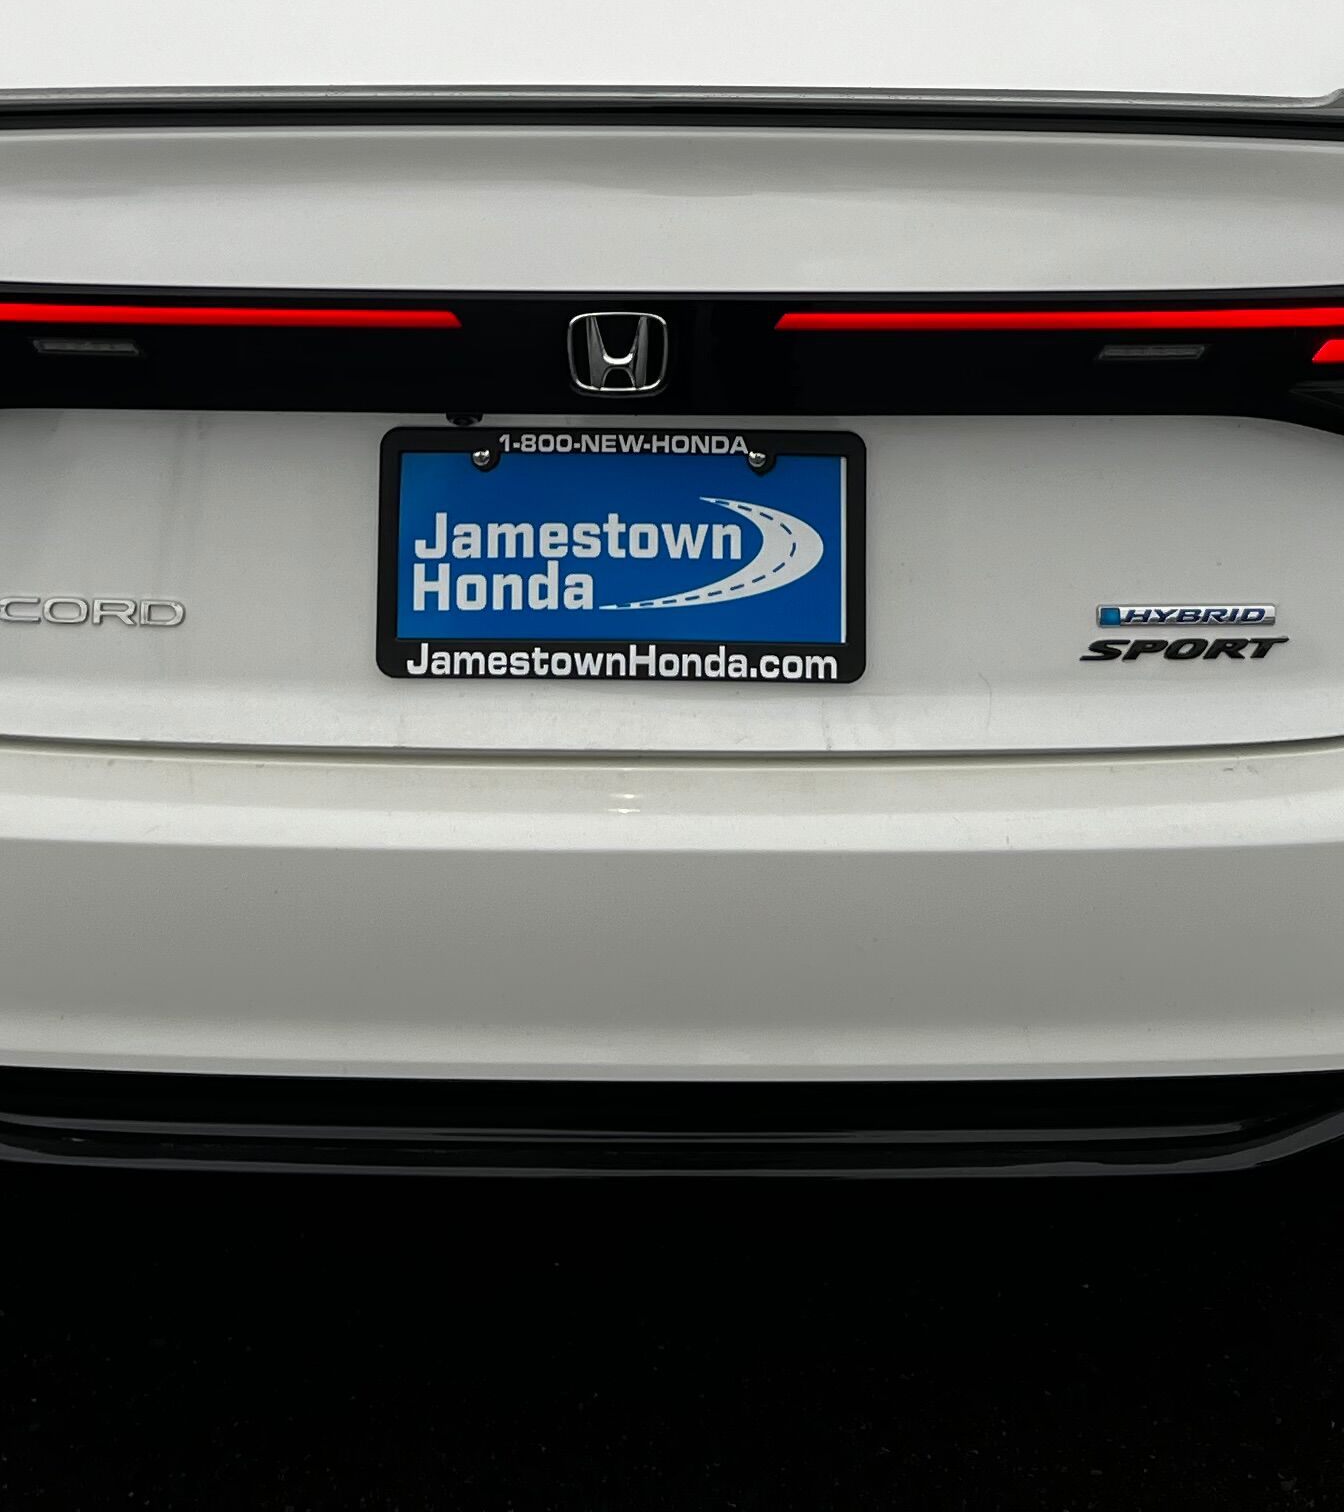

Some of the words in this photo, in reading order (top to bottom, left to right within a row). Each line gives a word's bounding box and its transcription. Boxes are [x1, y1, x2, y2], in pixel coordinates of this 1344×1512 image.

[499, 434, 749, 455] 1-800-NEW-HONDA
[414, 512, 743, 560] Jamestown
[413, 561, 594, 611] Honda
[1124, 608, 1266, 624] HYBRID
[406, 642, 838, 680] JamestownHonda.com
[1079, 635, 1290, 661] SPORT
